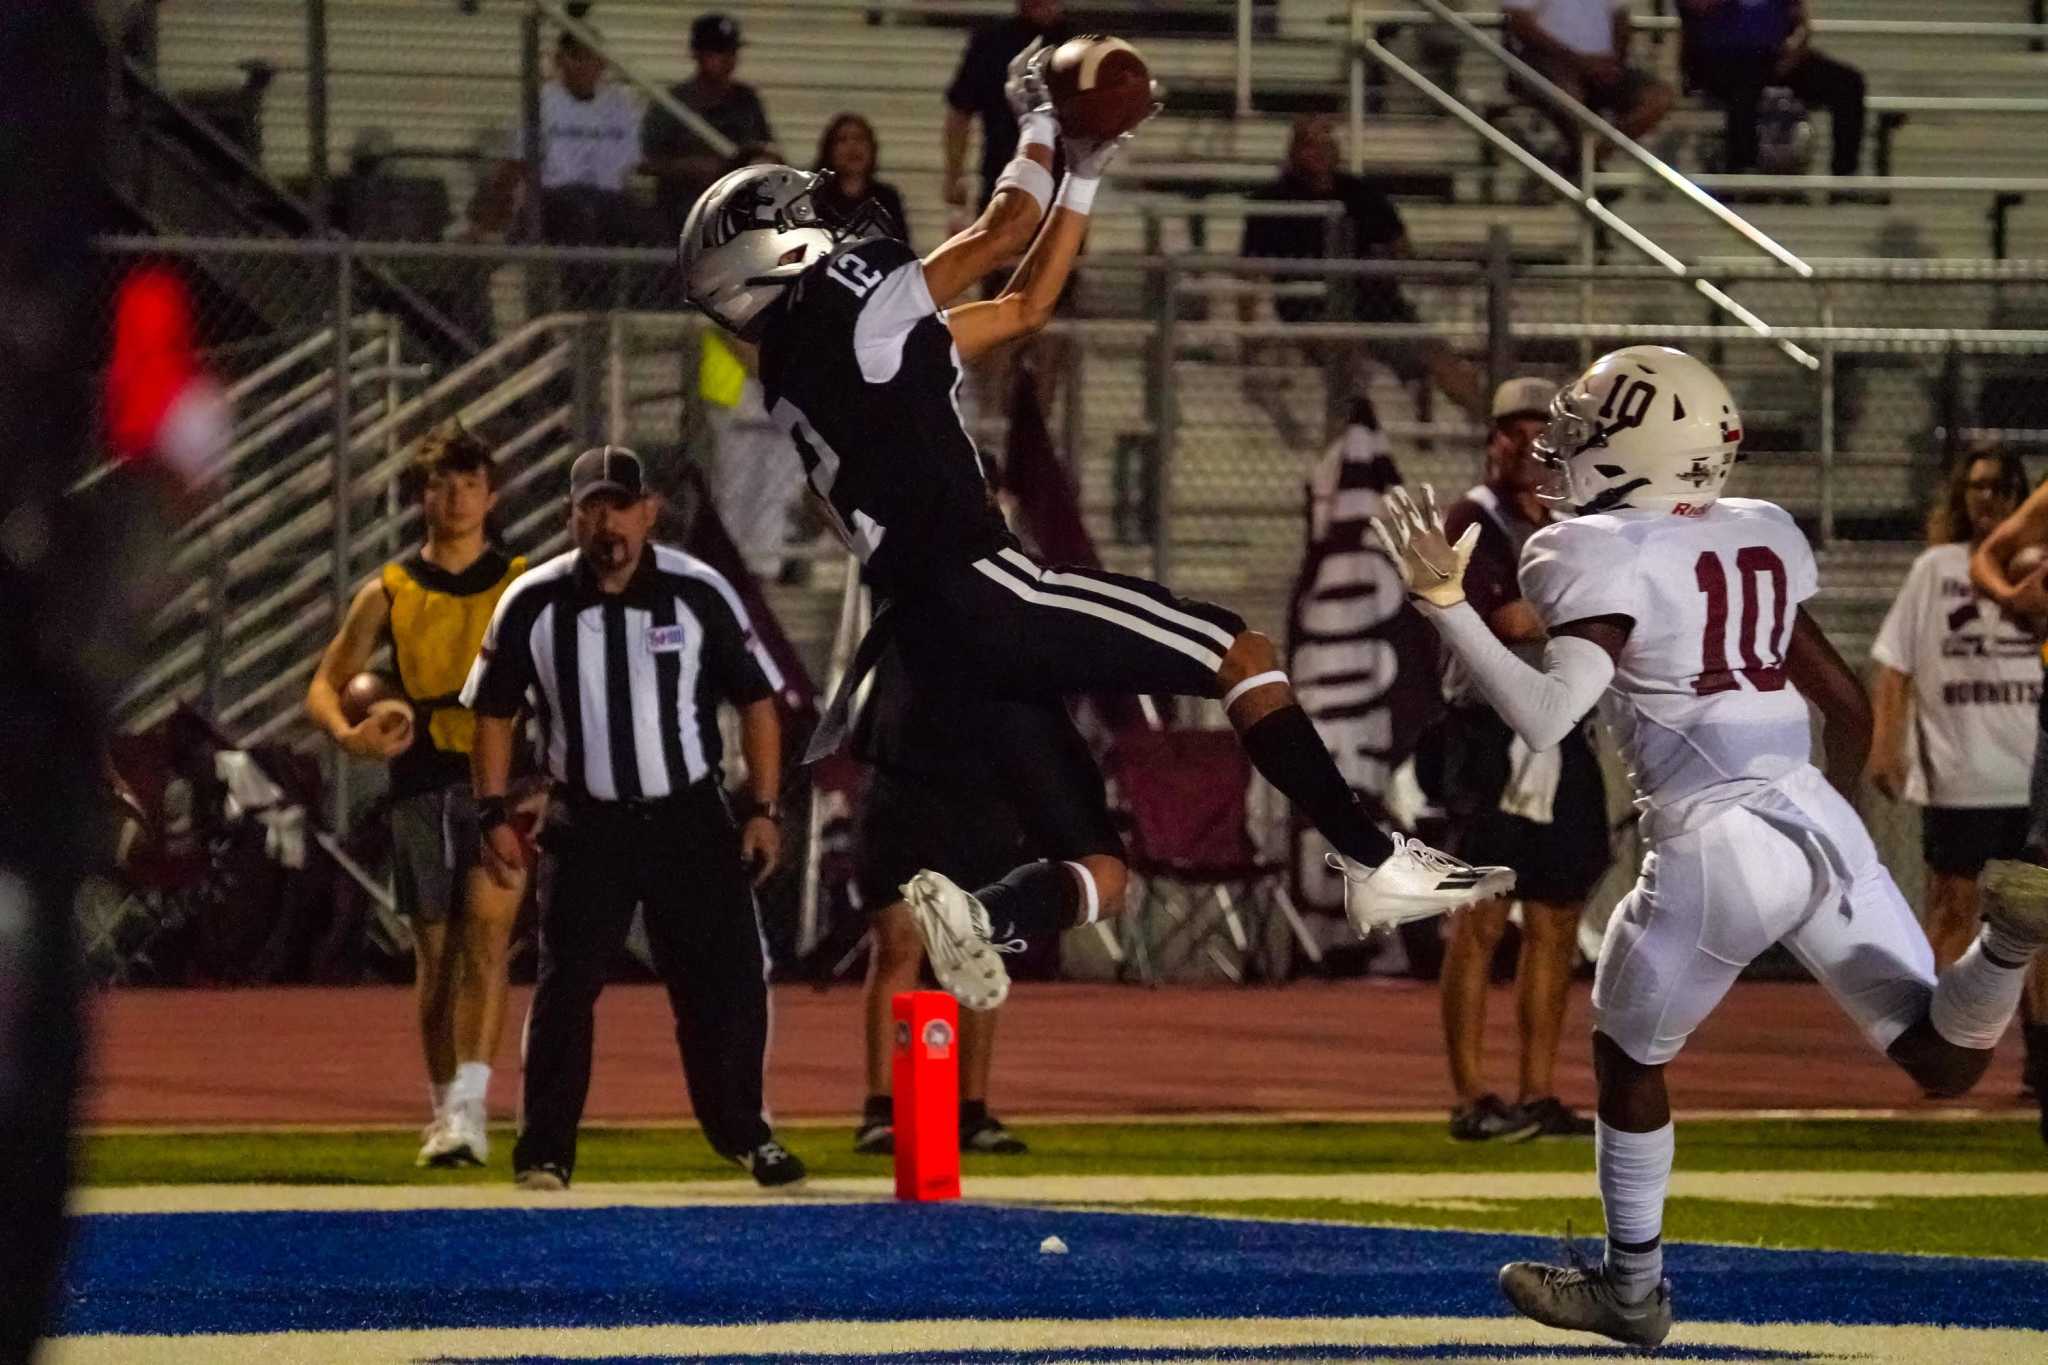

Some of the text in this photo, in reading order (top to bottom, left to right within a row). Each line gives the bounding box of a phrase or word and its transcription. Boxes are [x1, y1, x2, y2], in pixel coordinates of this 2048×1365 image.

[826, 252, 884, 298] 12
[1598, 374, 1656, 429] 10
[1690, 546, 1787, 697] 10
